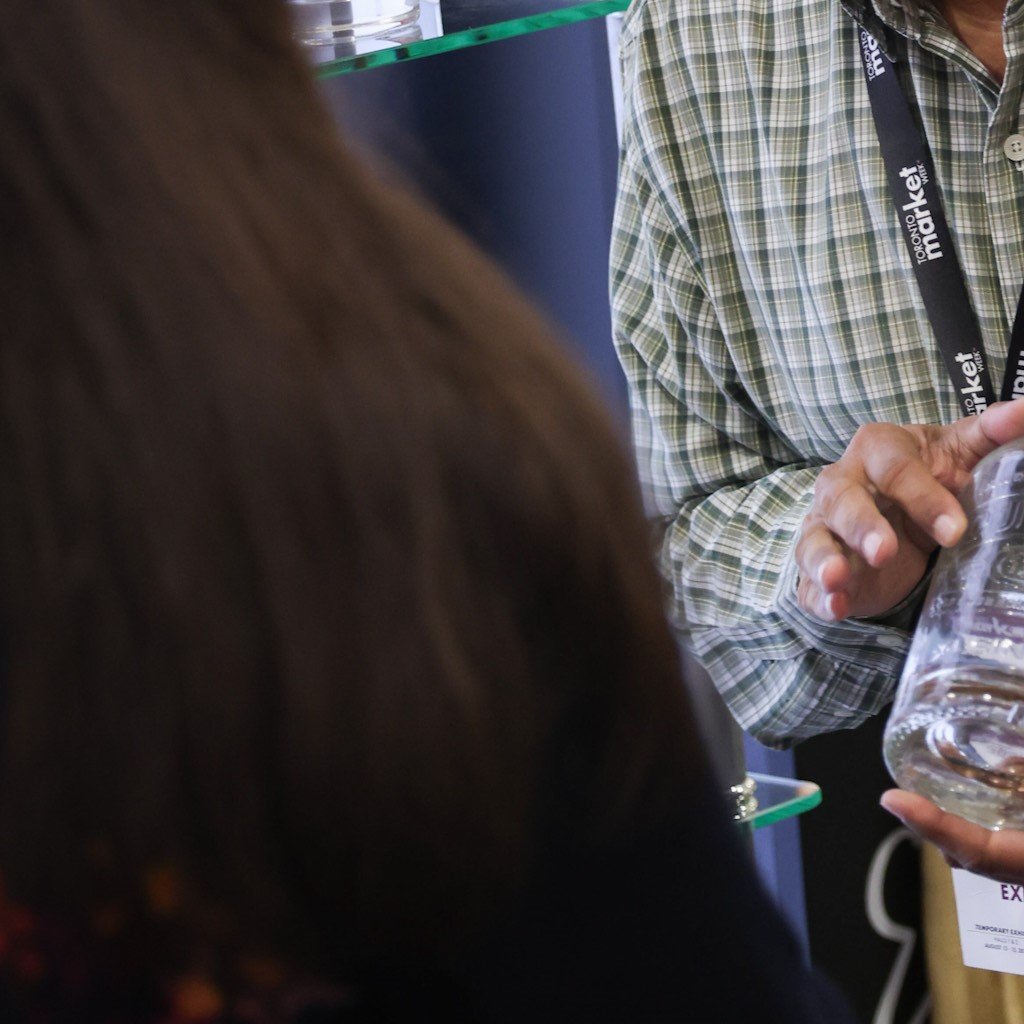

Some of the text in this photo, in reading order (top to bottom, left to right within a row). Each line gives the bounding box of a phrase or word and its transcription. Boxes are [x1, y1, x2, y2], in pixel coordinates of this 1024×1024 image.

[860, 31, 876, 81] TORONTO
[917, 162, 930, 185] WEEK
[898, 166, 944, 261] market
[905, 214, 928, 265] TORONTO
[972, 350, 985, 373] WEEK
